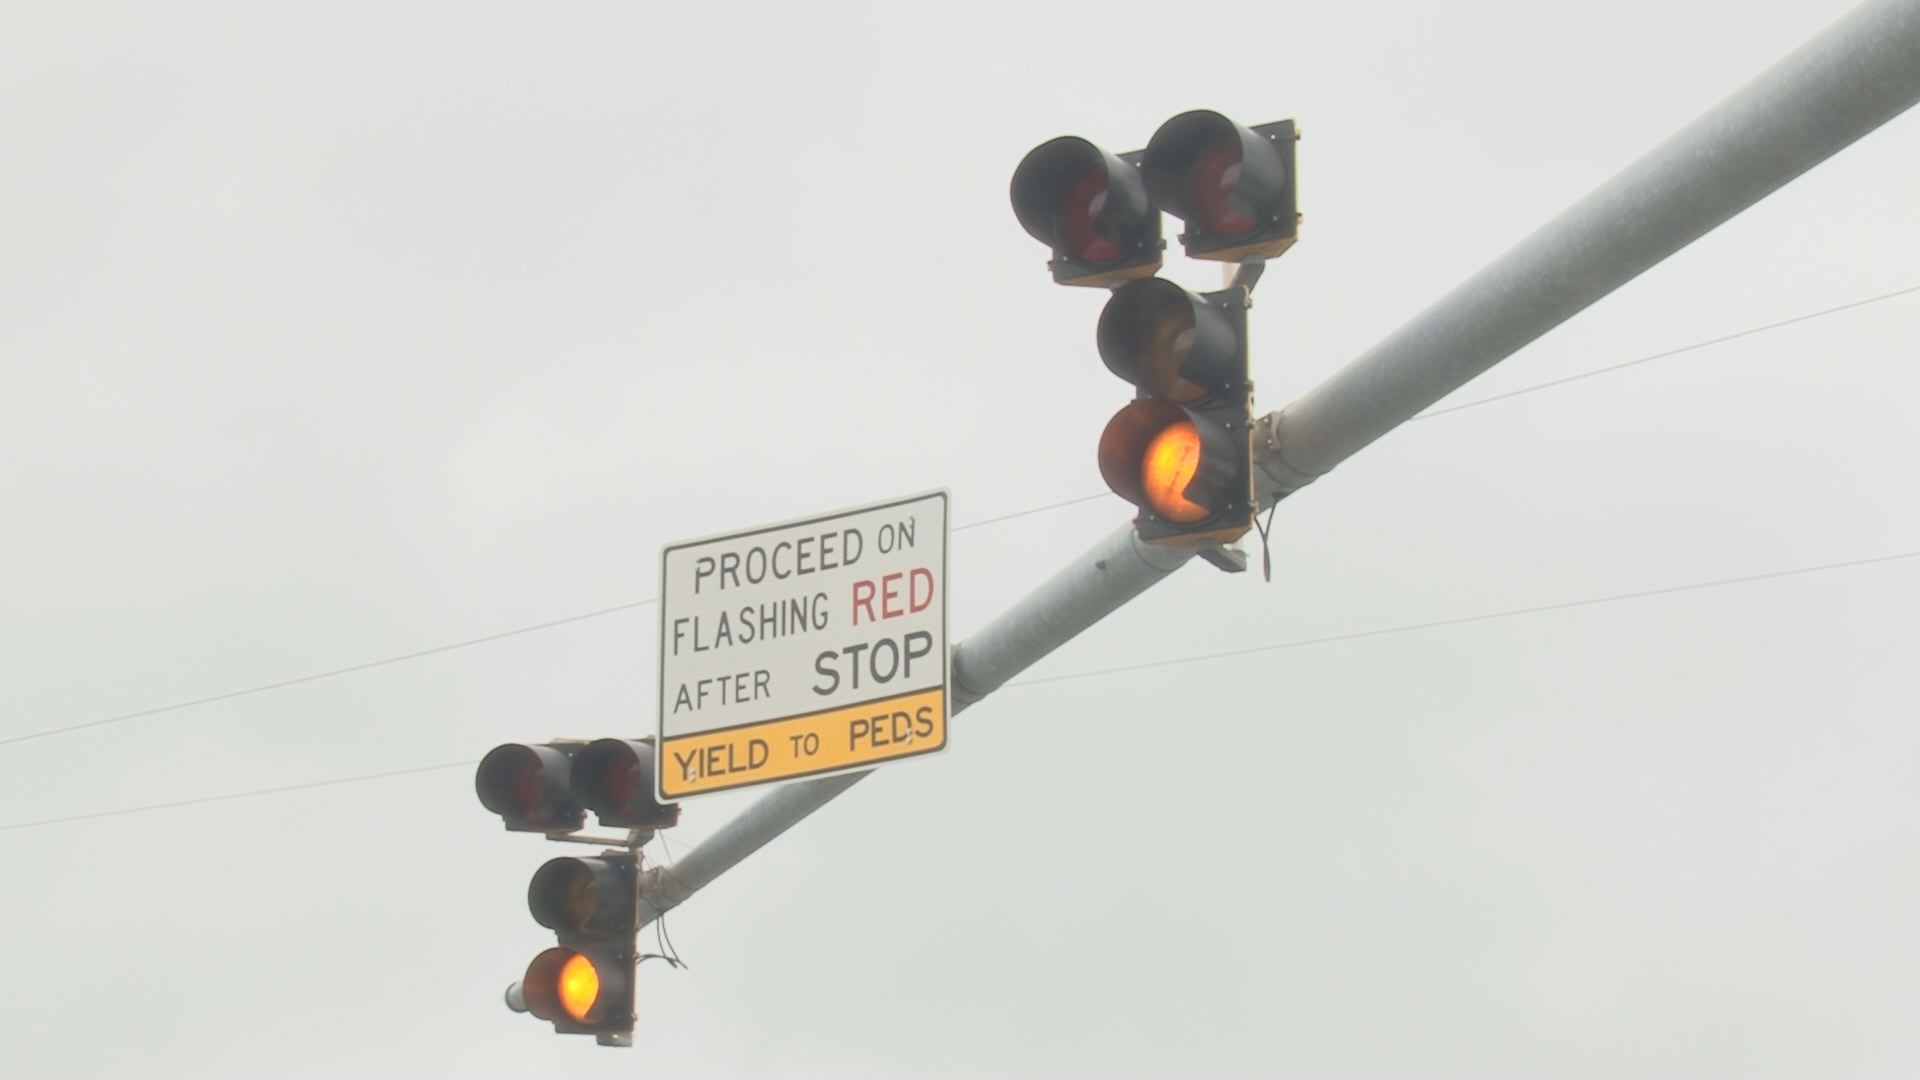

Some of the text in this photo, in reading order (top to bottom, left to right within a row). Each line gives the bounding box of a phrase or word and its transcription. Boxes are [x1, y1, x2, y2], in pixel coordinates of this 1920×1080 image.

[695, 517, 915, 594] PROCEED ON
[674, 567, 934, 655] FLASHING RED
[673, 630, 933, 714] AFTER STOP
[673, 706, 934, 781] YIELD TO PEDS
